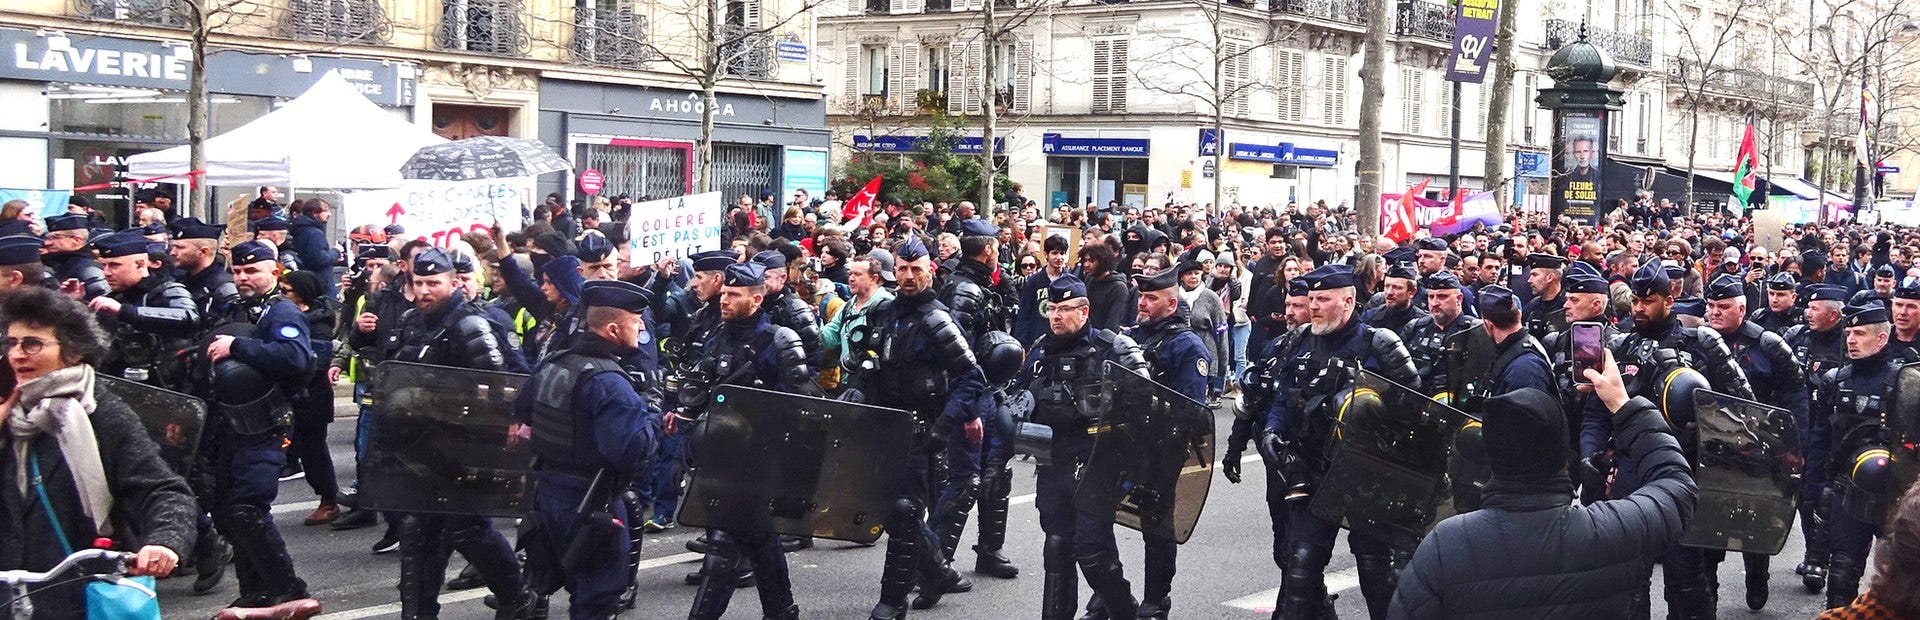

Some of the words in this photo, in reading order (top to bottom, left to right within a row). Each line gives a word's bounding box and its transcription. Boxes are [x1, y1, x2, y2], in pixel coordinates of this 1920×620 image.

[15, 42, 188, 81] LAVERIE
[1569, 181, 1594, 191] FLEURS
[1564, 191, 1574, 200] DE
[1575, 191, 1597, 200] SOLEIL
[668, 198, 685, 210] LA
[631, 232, 665, 249] N'EST
[674, 228, 699, 242] PAS
[705, 226, 721, 238] UN
